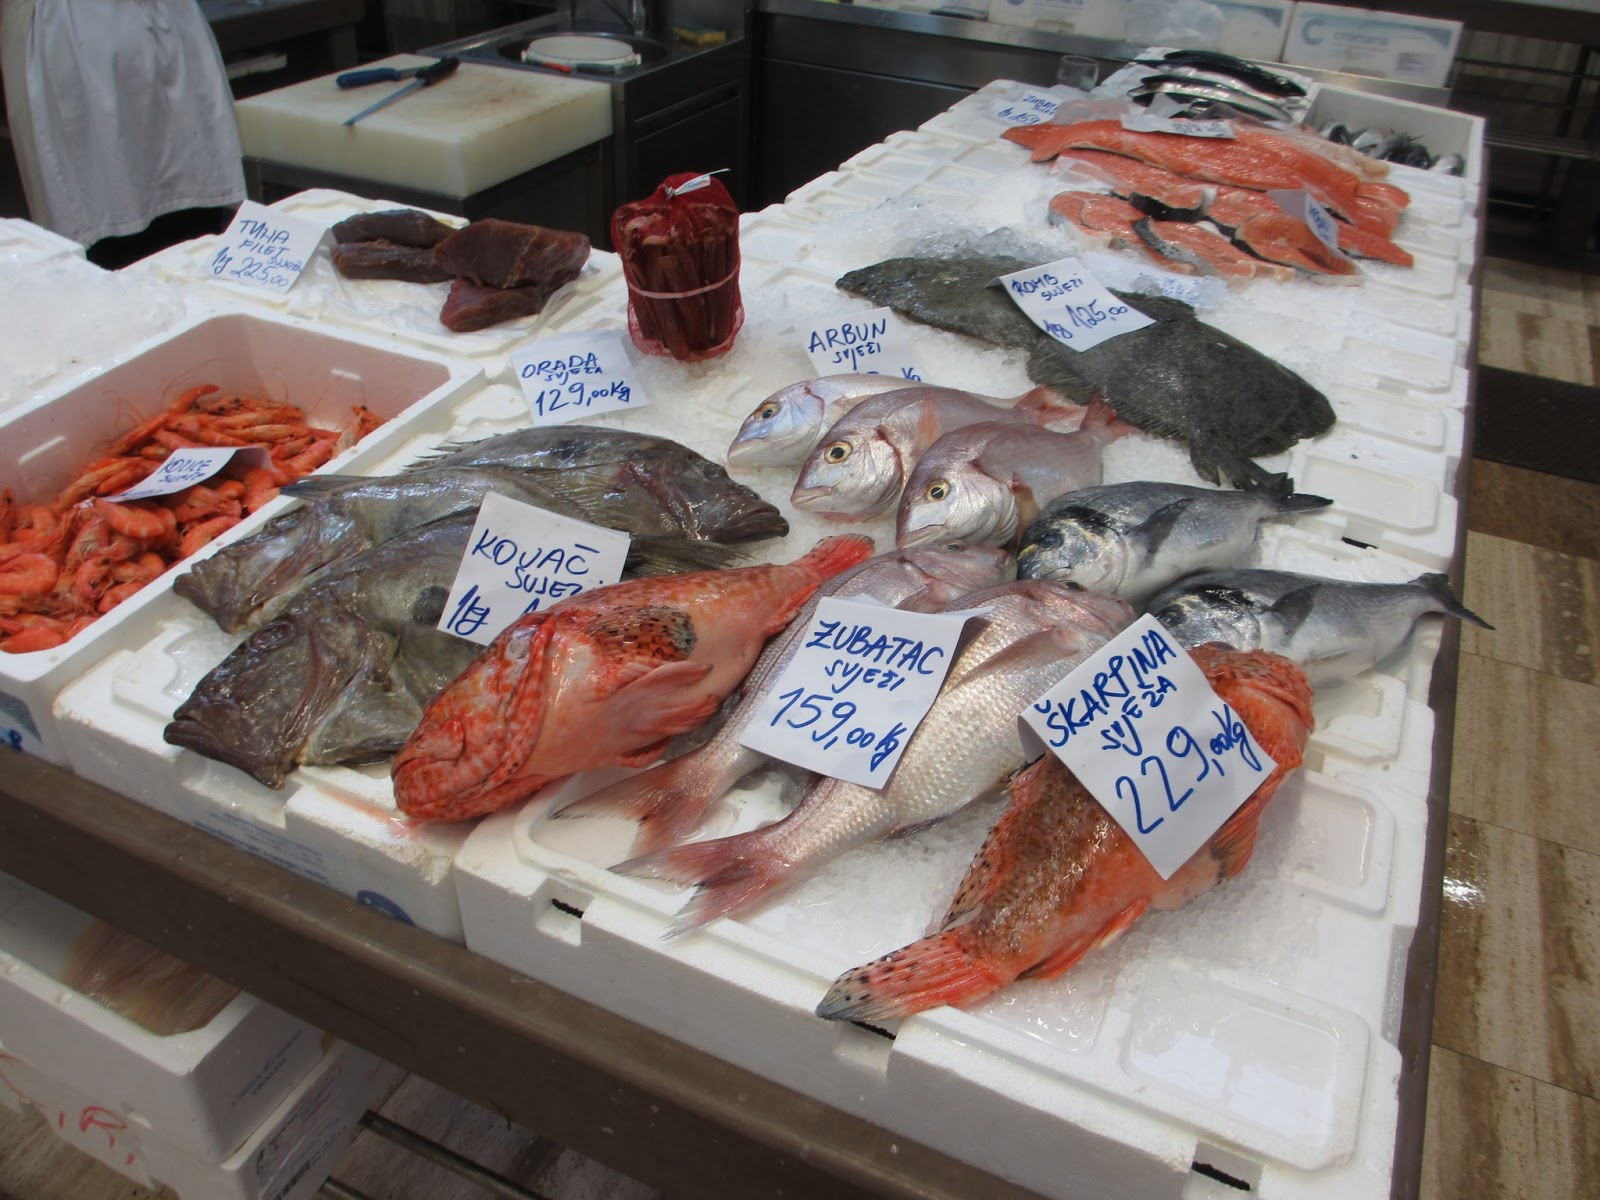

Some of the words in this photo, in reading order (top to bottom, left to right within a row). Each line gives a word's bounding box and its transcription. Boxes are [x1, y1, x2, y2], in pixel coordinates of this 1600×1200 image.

[240, 220, 290, 244] TUNA
[238, 239, 291, 260] FILET
[1012, 274, 1058, 297] ROMB
[808, 318, 886, 353] ARBUN
[521, 352, 599, 379] ORADA
[804, 619, 945, 675] ZUBATAC
[1033, 628, 1178, 748] ŠKARPINA
